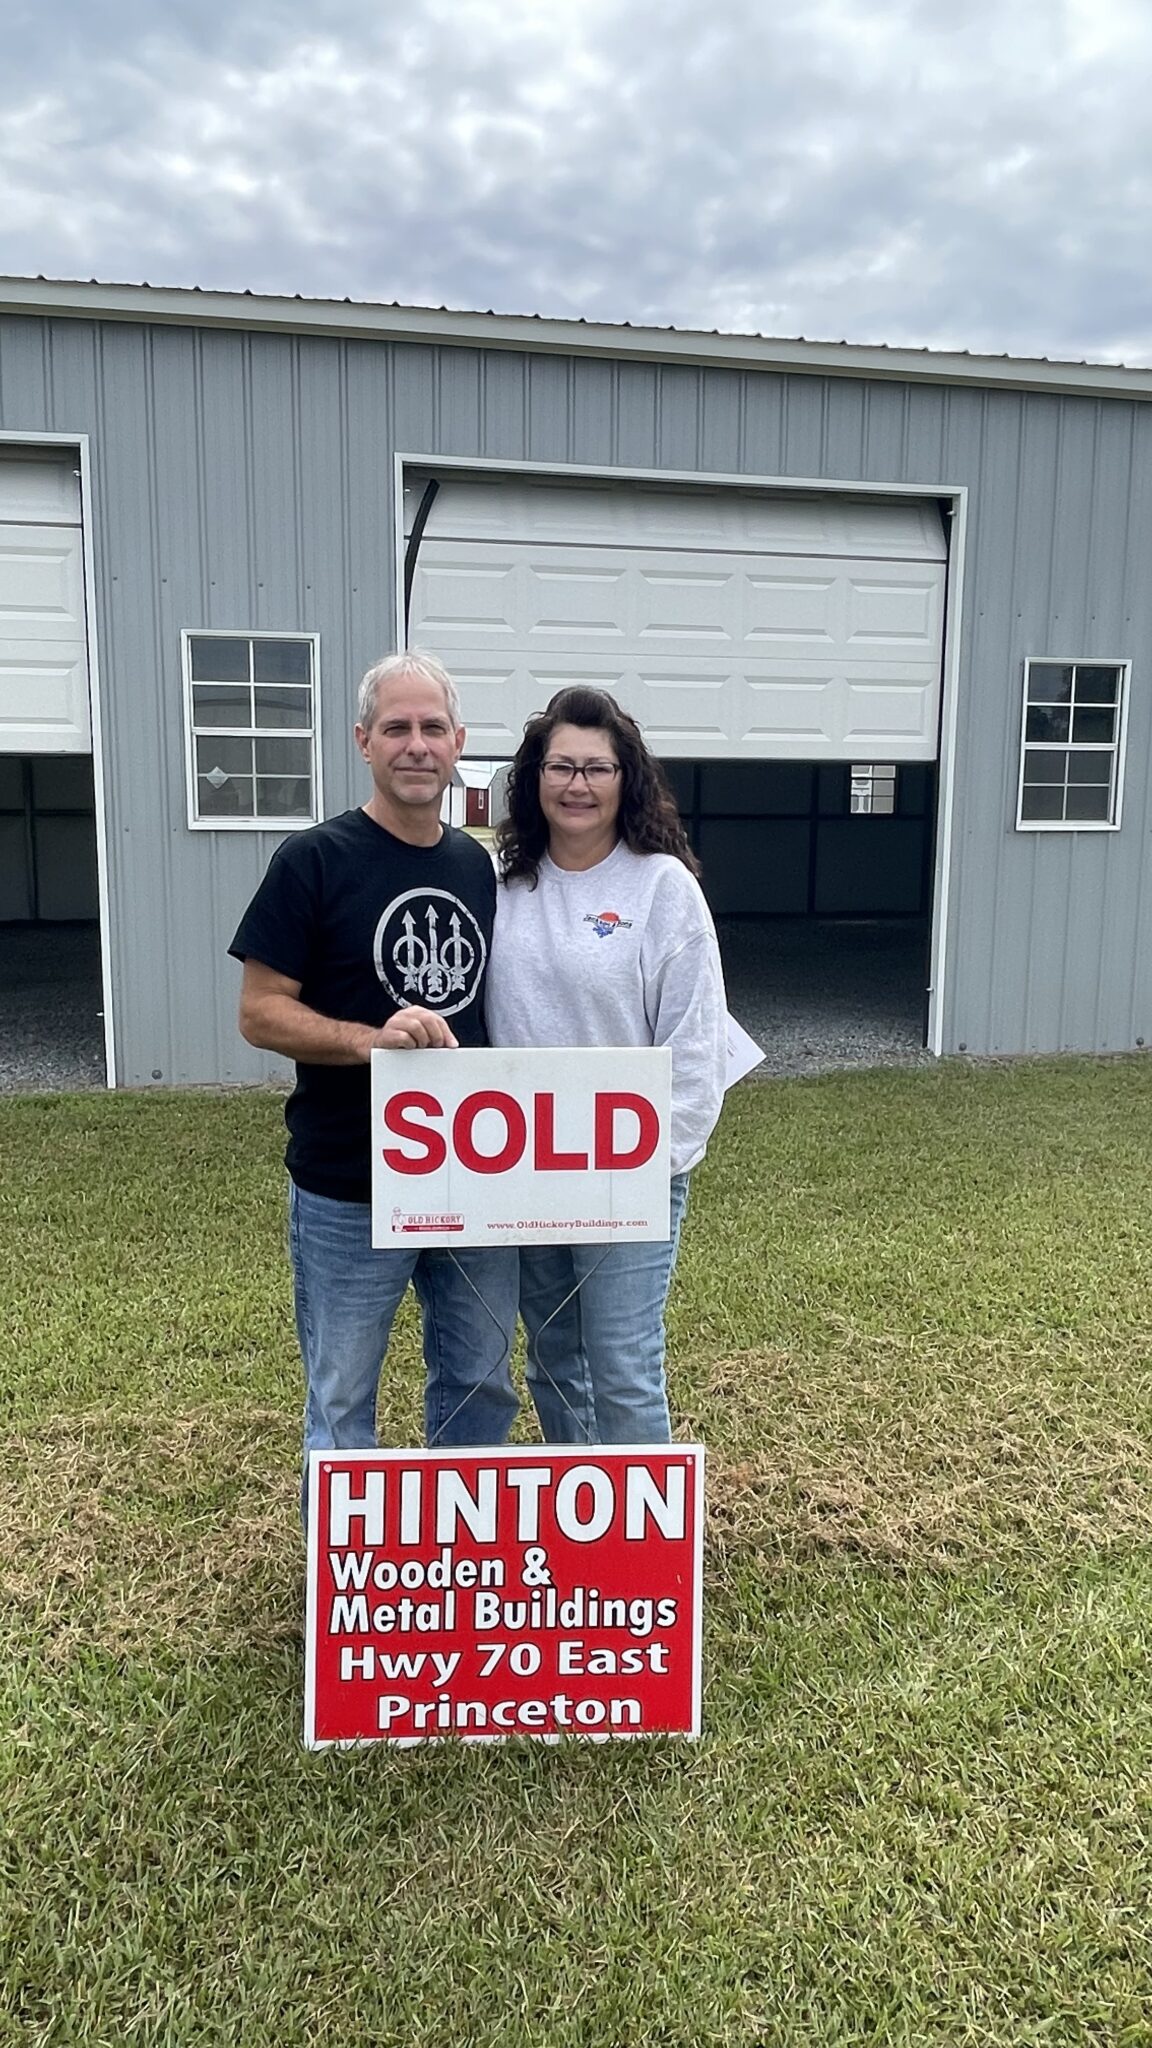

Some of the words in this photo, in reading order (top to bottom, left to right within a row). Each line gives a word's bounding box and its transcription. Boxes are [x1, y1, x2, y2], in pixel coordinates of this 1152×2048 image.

[382, 1090, 660, 1175] SOLD
[408, 1216, 424, 1224] OLD
[425, 1215, 461, 1224] HICKORY
[487, 1219, 648, 1230] www.OldHickoryBuildings.com
[328, 1464, 686, 1547] HINTON
[328, 1547, 505, 1591] Wooden
[520, 1546, 554, 1587] &
[328, 1589, 455, 1634] Metal
[474, 1587, 678, 1636] Buildings
[339, 1645, 462, 1688] Hwy
[475, 1642, 542, 1677] 70
[557, 1640, 671, 1676] East
[377, 1693, 642, 1730] Princeton
